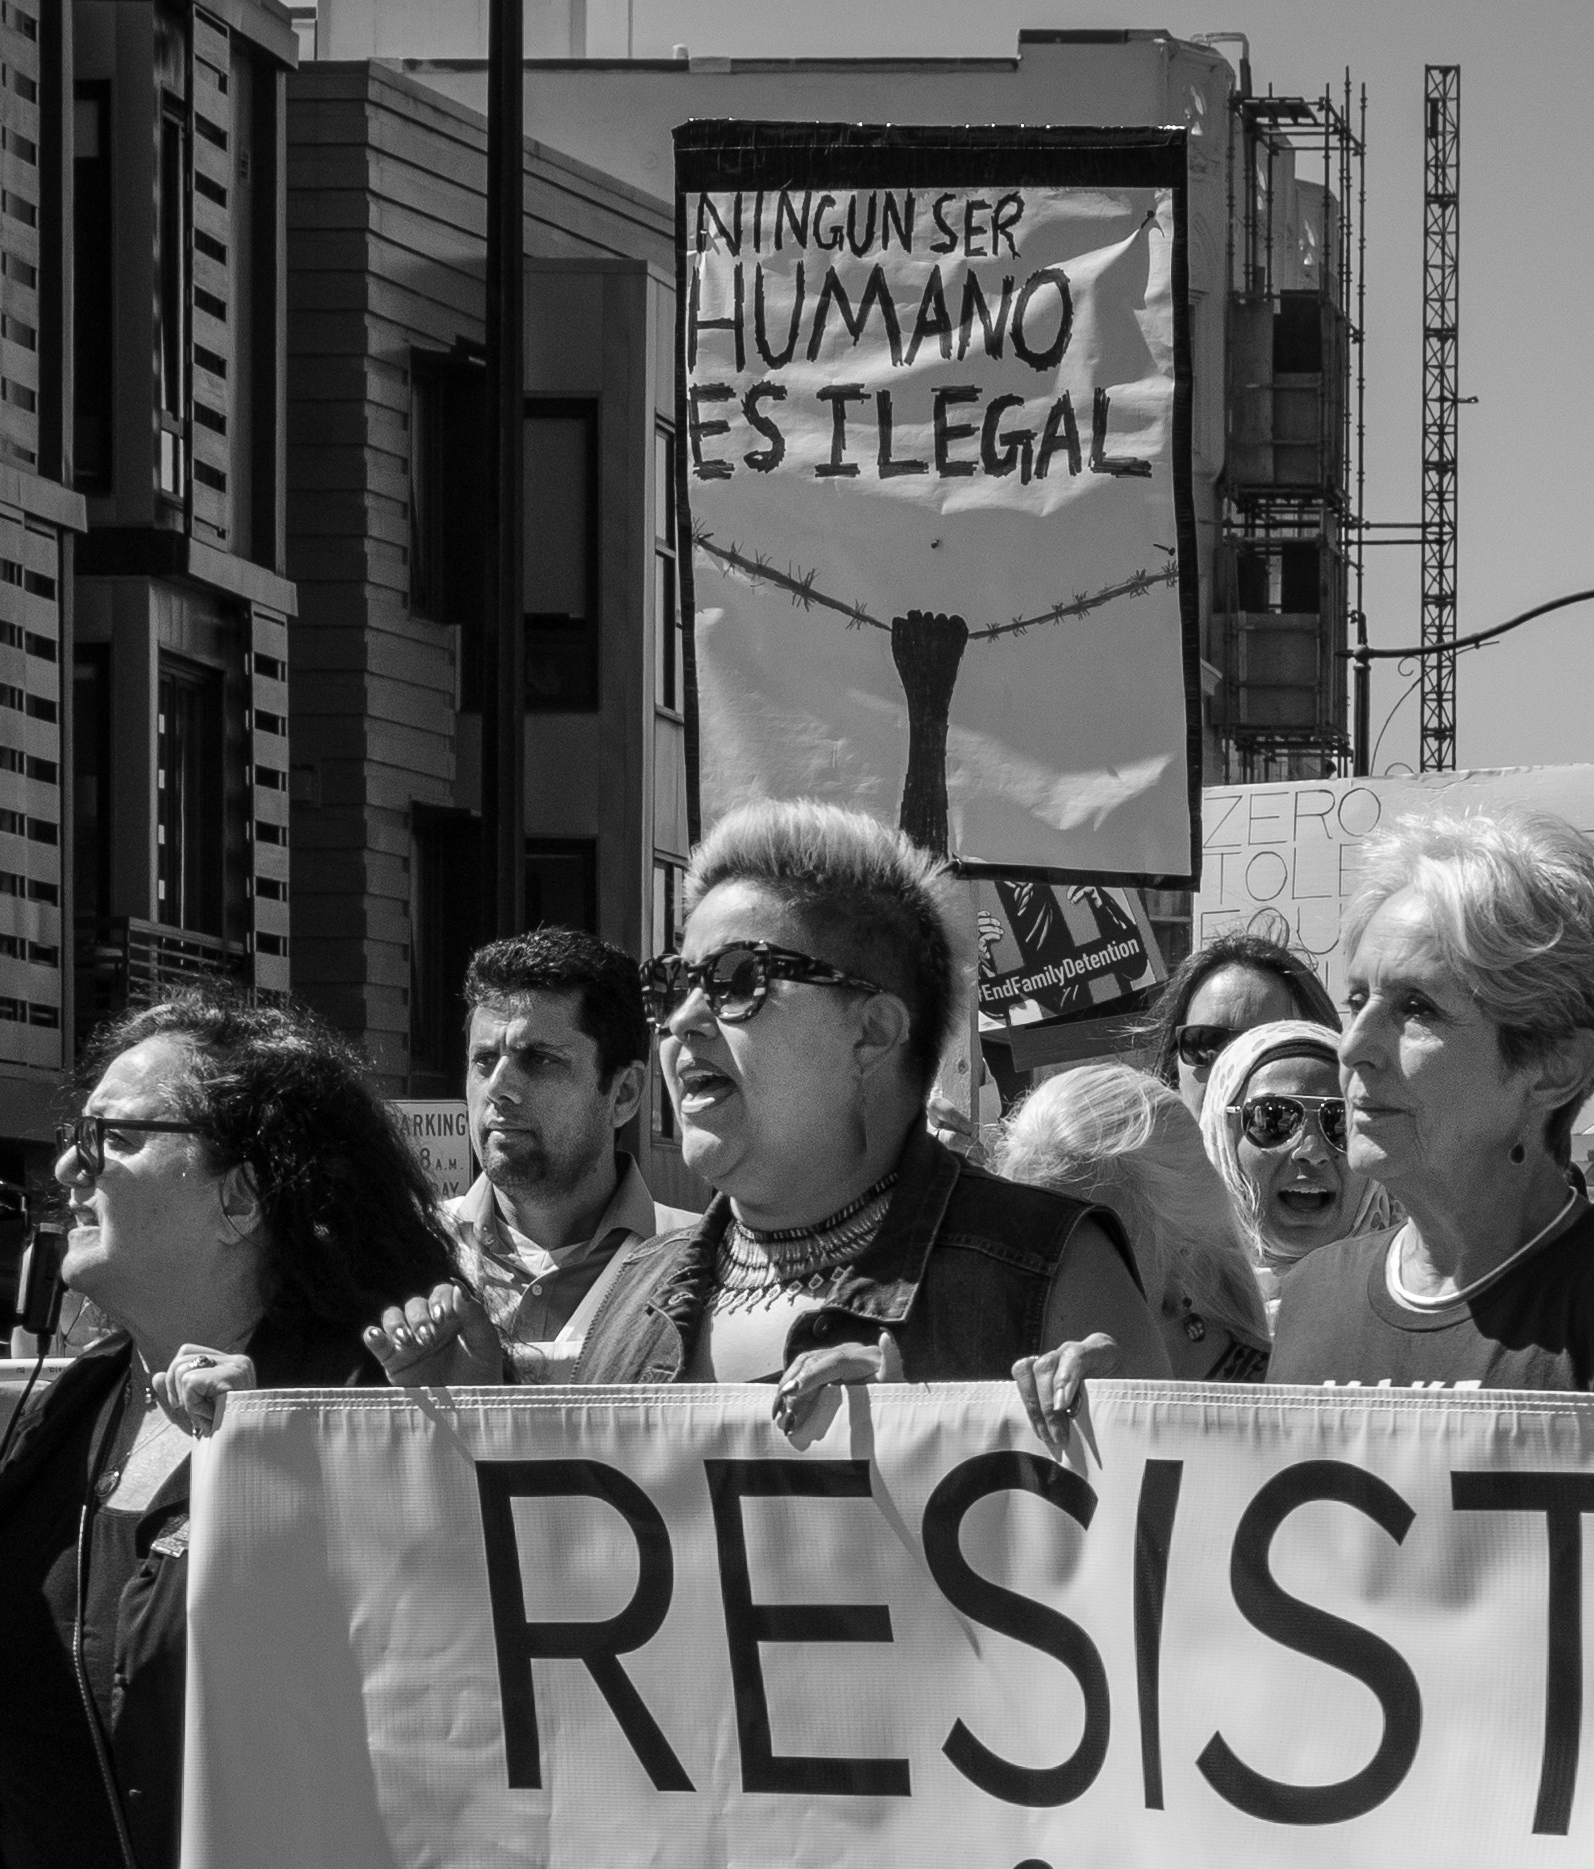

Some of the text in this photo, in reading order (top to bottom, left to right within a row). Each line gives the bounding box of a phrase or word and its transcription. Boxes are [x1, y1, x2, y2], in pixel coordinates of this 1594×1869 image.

[695, 188, 1026, 261] NINGUN SER
[687, 261, 1075, 373] HUMANO
[689, 380, 1154, 486] ES ILEGAL
[1202, 787, 1382, 849] ZERO
